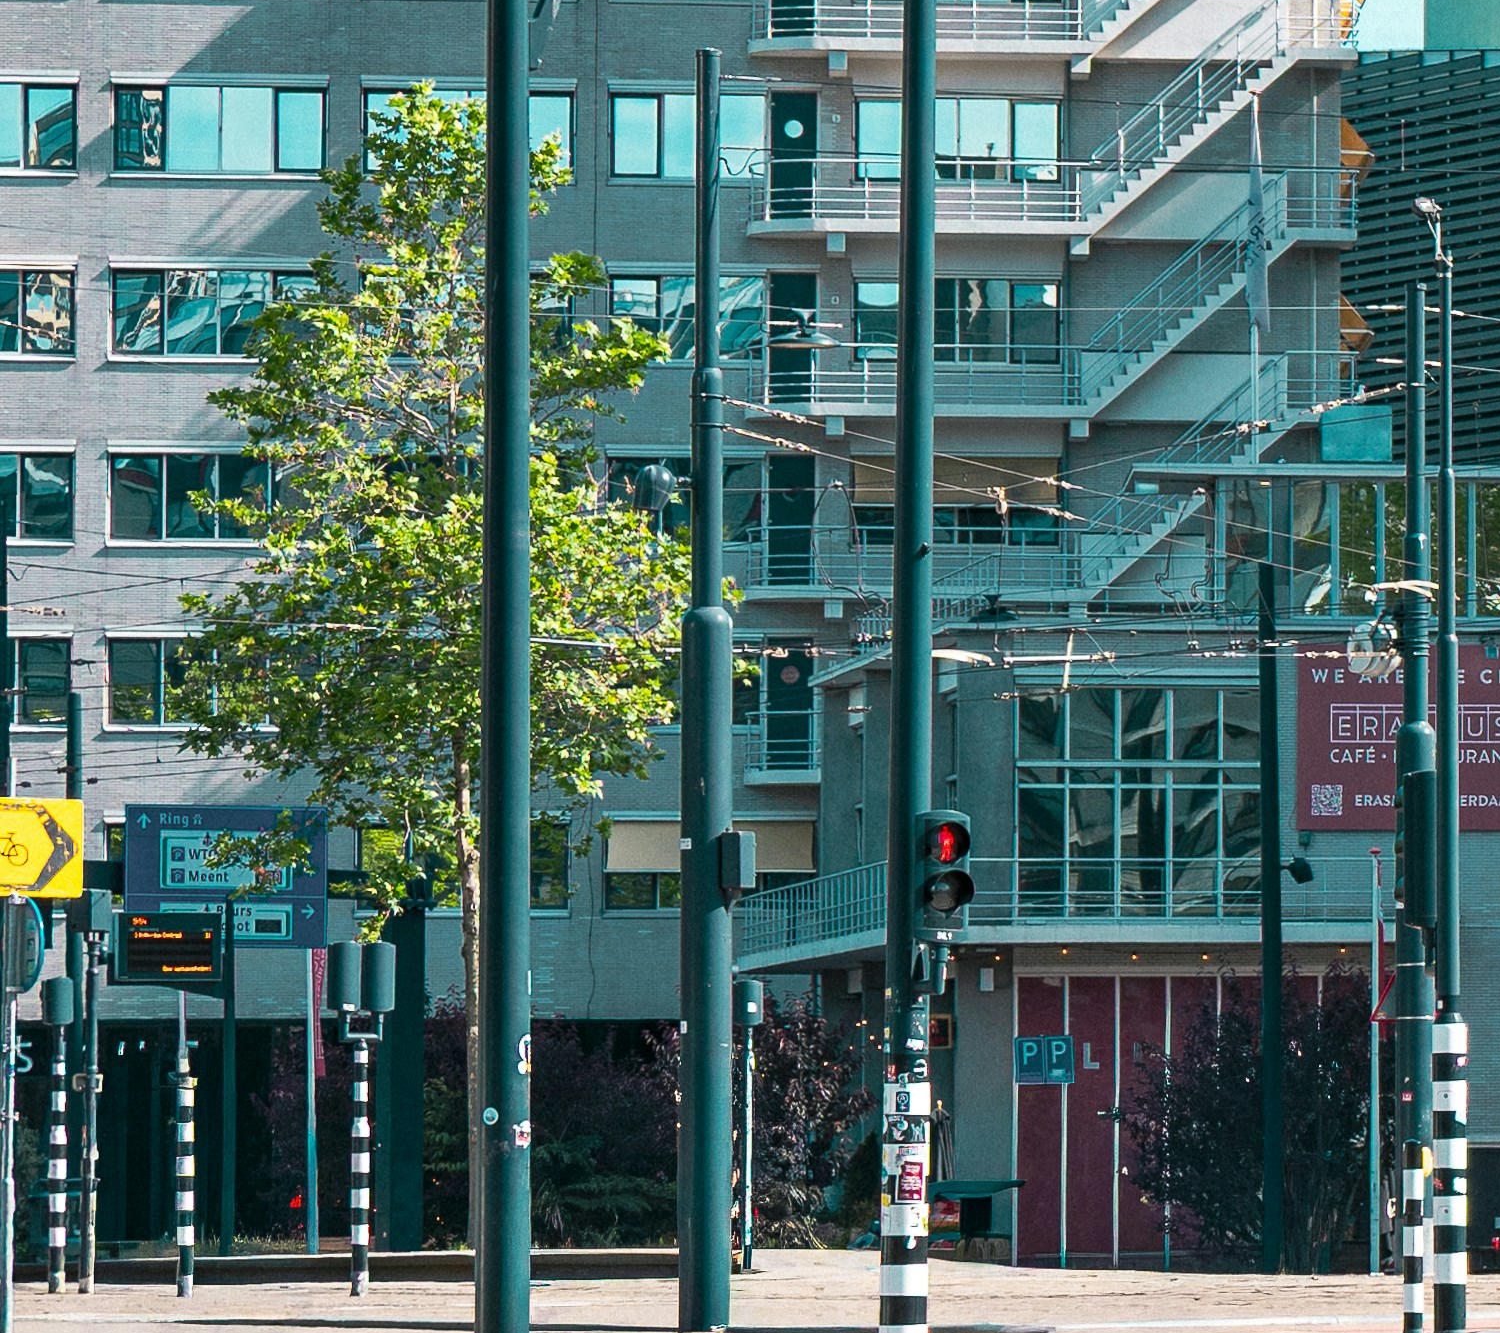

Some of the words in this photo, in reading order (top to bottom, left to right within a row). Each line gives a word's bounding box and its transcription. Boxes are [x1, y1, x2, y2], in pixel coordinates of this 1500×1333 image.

[1311, 668, 1345, 684] WE
[1358, 668, 1404, 684] ARE
[1330, 746, 1376, 764] CAFÉ
[159, 812, 190, 827] Ring
[188, 871, 229, 883] Meent
[216, 905, 253, 917] Burs
